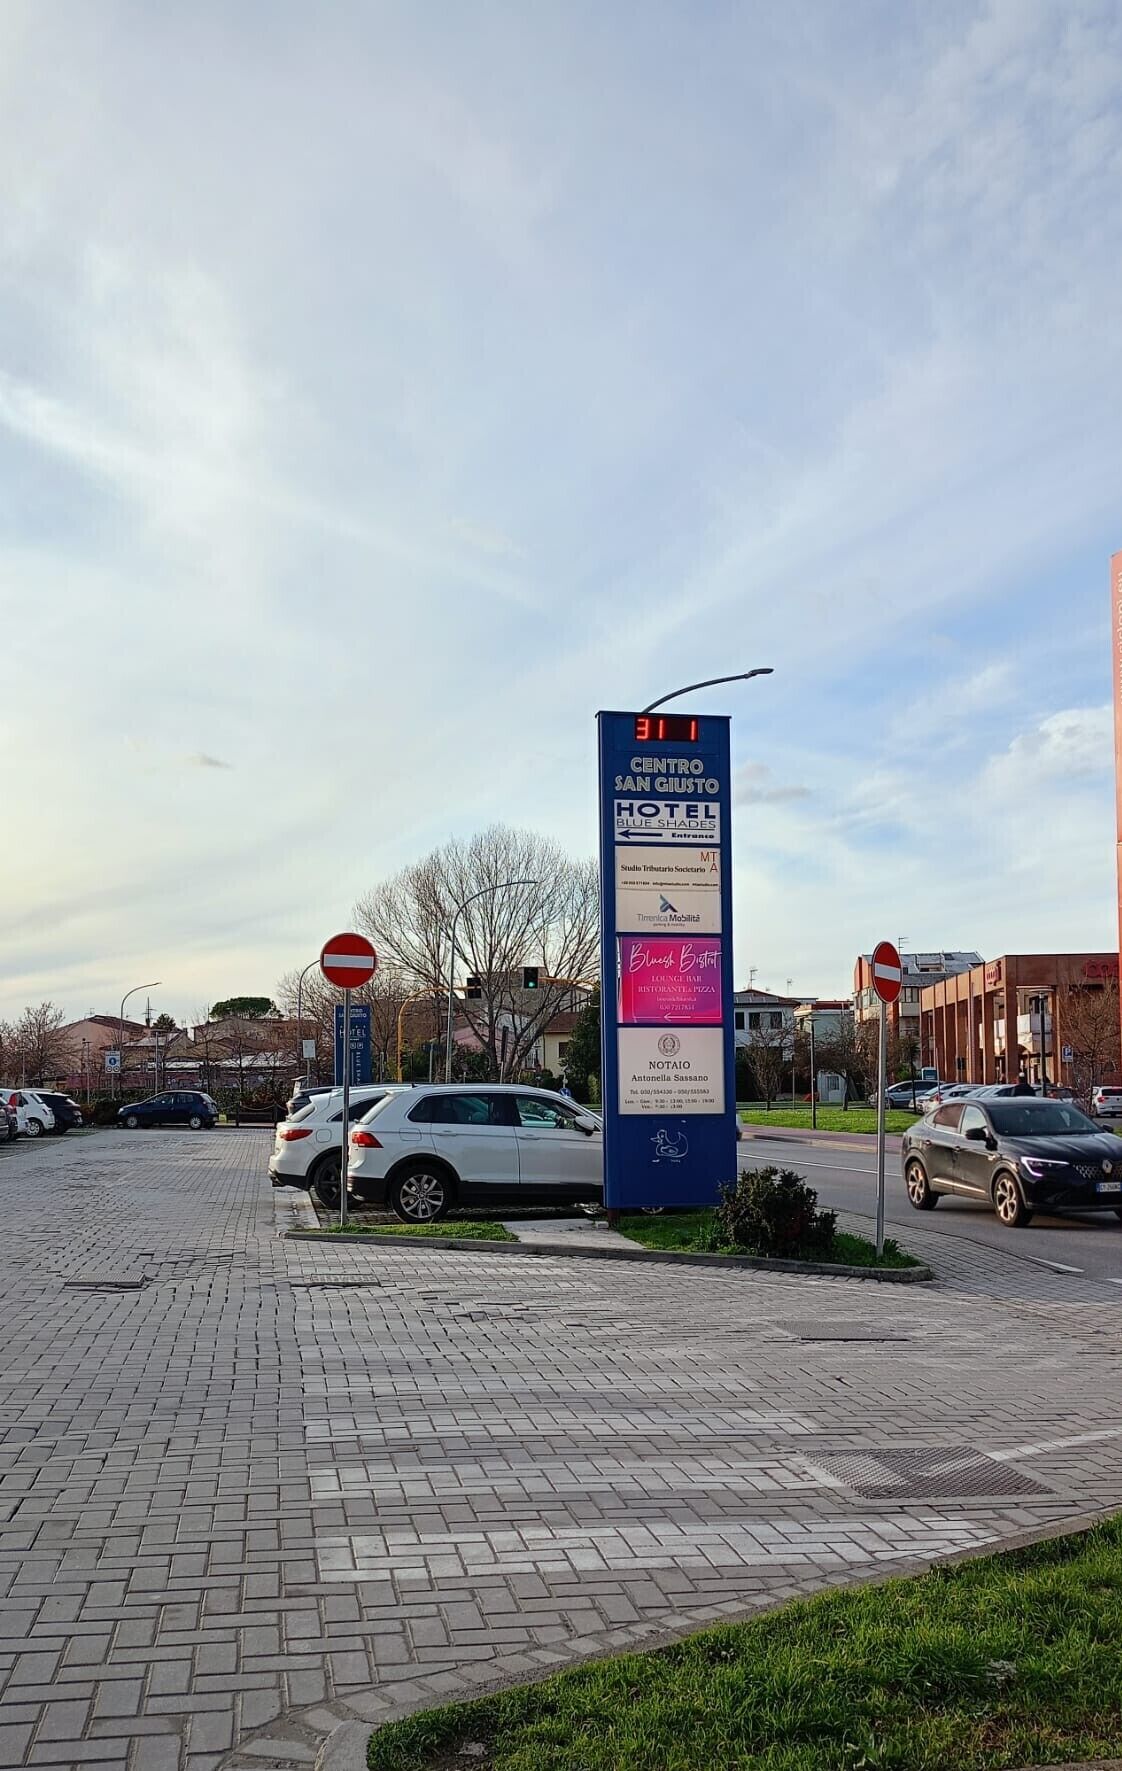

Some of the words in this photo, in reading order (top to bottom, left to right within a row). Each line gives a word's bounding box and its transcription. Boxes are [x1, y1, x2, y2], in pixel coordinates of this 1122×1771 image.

[636, 719, 664, 741] 31
[690, 720, 697, 741] 1
[630, 757, 704, 775] CENTRO
[614, 775, 652, 792] SAN
[654, 777, 720, 794] GIUSTO
[616, 802, 716, 819] HOTEL
[616, 819, 652, 828] BLUE
[658, 819, 716, 829] SHADES
[671, 832, 715, 840] Entrance
[620, 864, 642, 872] Studio
[643, 865, 674, 873] Tributario
[686, 975, 702, 983] BAR
[638, 985, 687, 993] RISTORANTE
[693, 985, 716, 993] PIZZA
[339, 1028, 366, 1036] HTEL
[648, 1061, 691, 1070] NOTAIO
[631, 1074, 671, 1082] Antonella
[673, 1074, 709, 1082] Sassano
